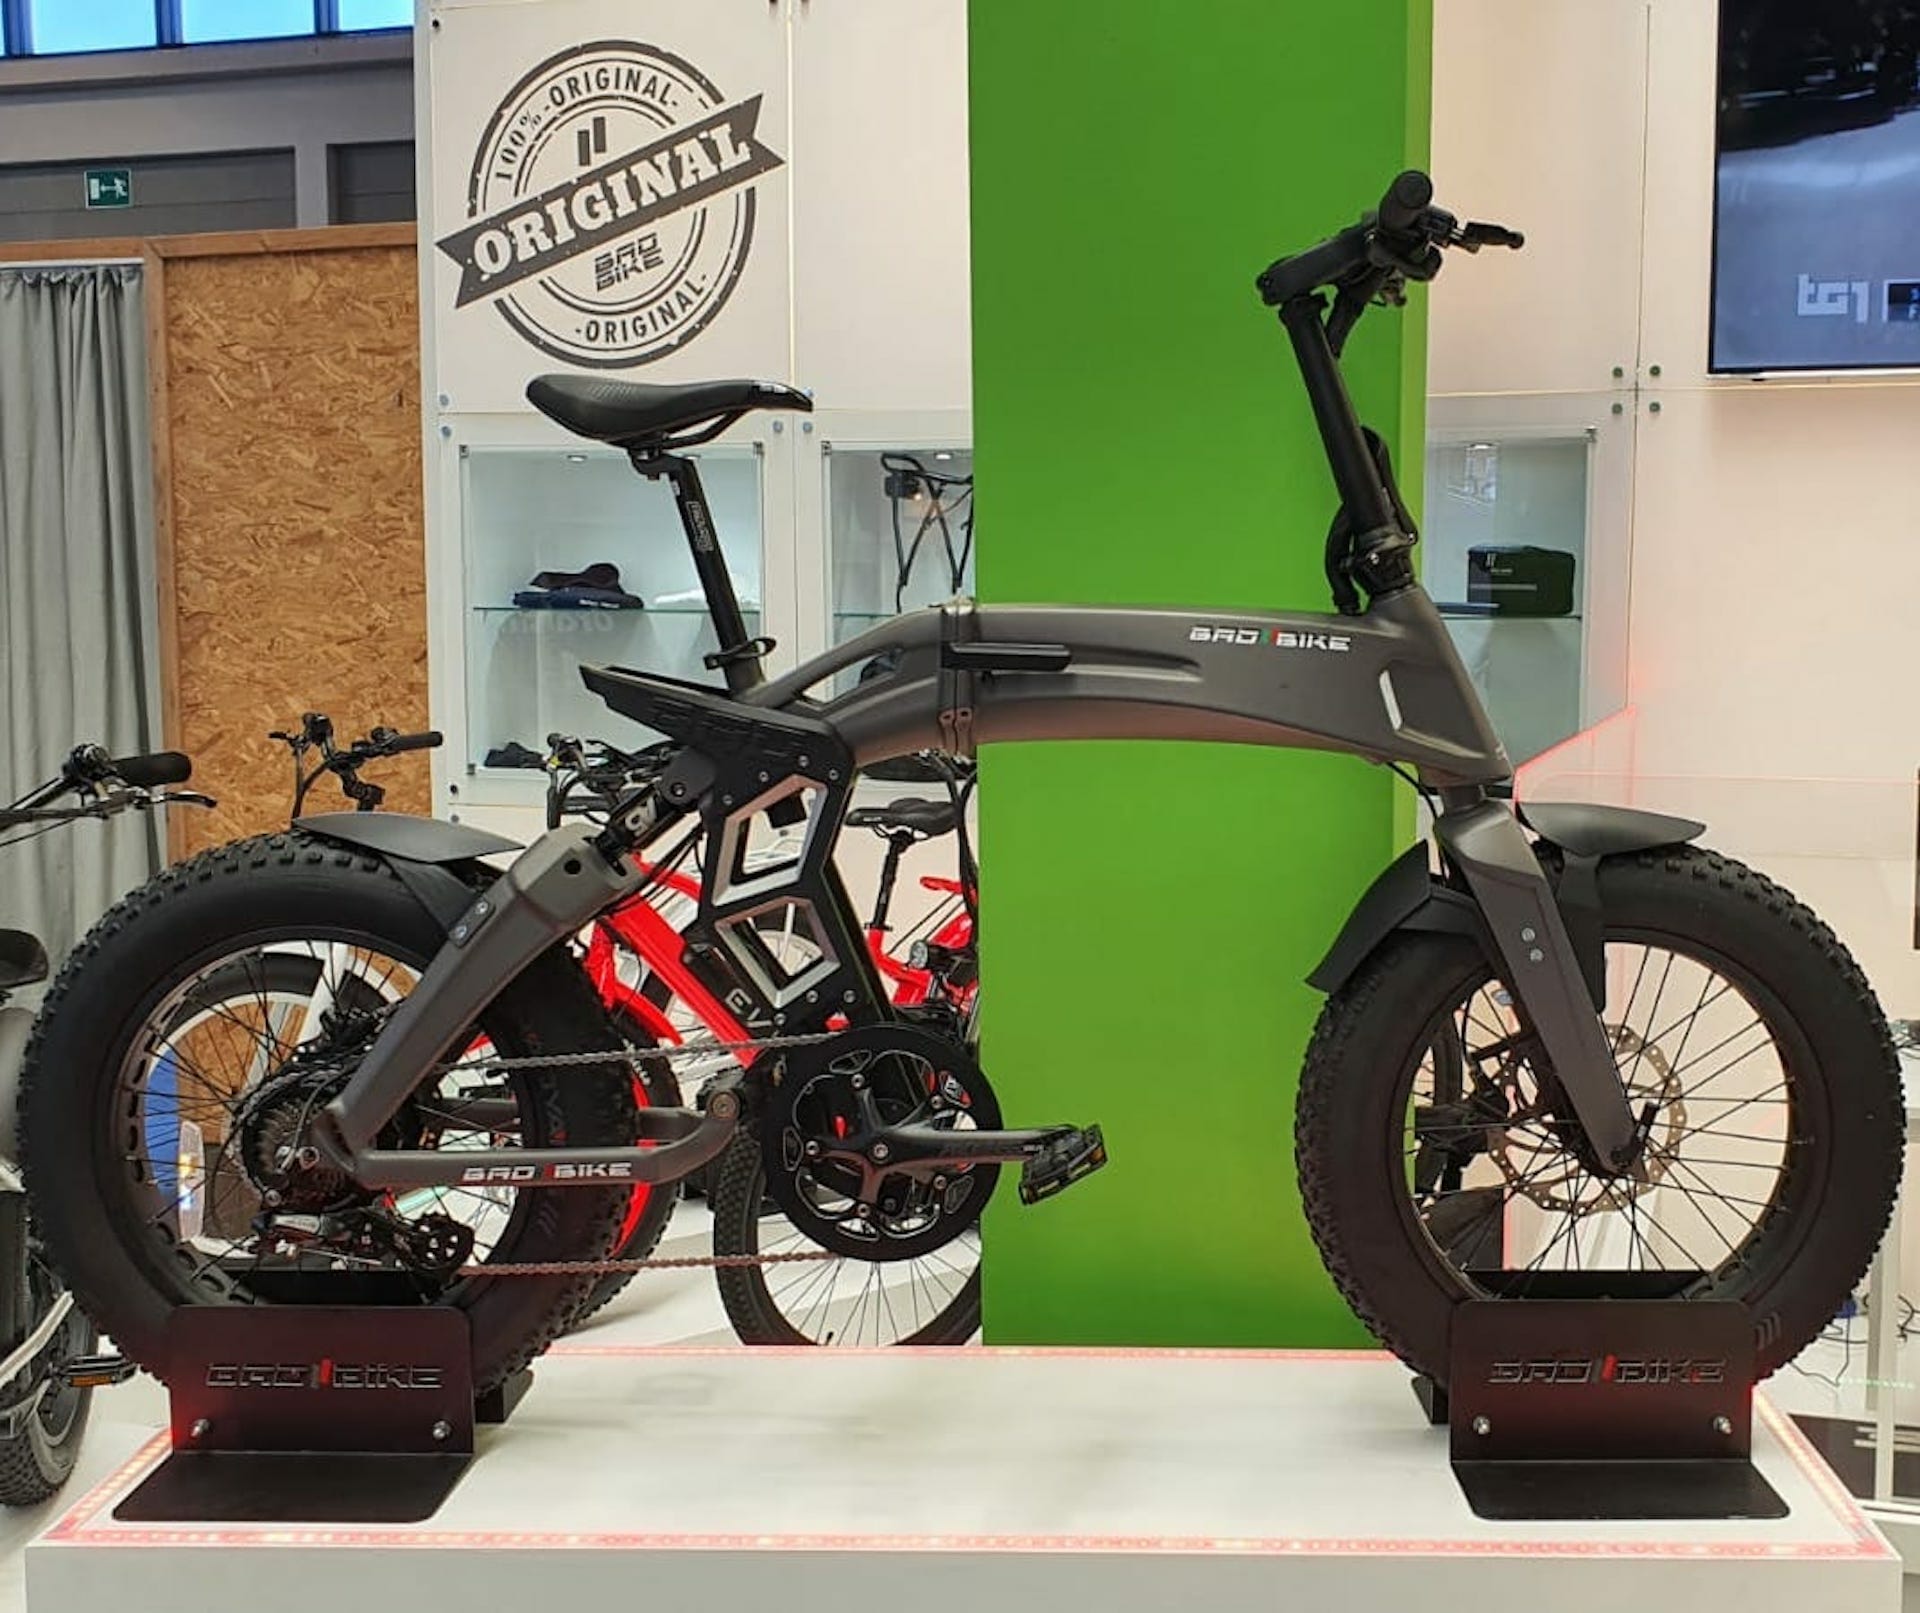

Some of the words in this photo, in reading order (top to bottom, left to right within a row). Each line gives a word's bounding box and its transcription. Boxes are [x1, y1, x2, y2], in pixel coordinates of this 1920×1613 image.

[495, 110, 543, 182] 100%
[473, 122, 752, 275] ORIGINAL
[595, 232, 657, 273] BAD
[1276, 632, 1351, 651] BIKE
[554, 1162, 632, 1179] BIKE
